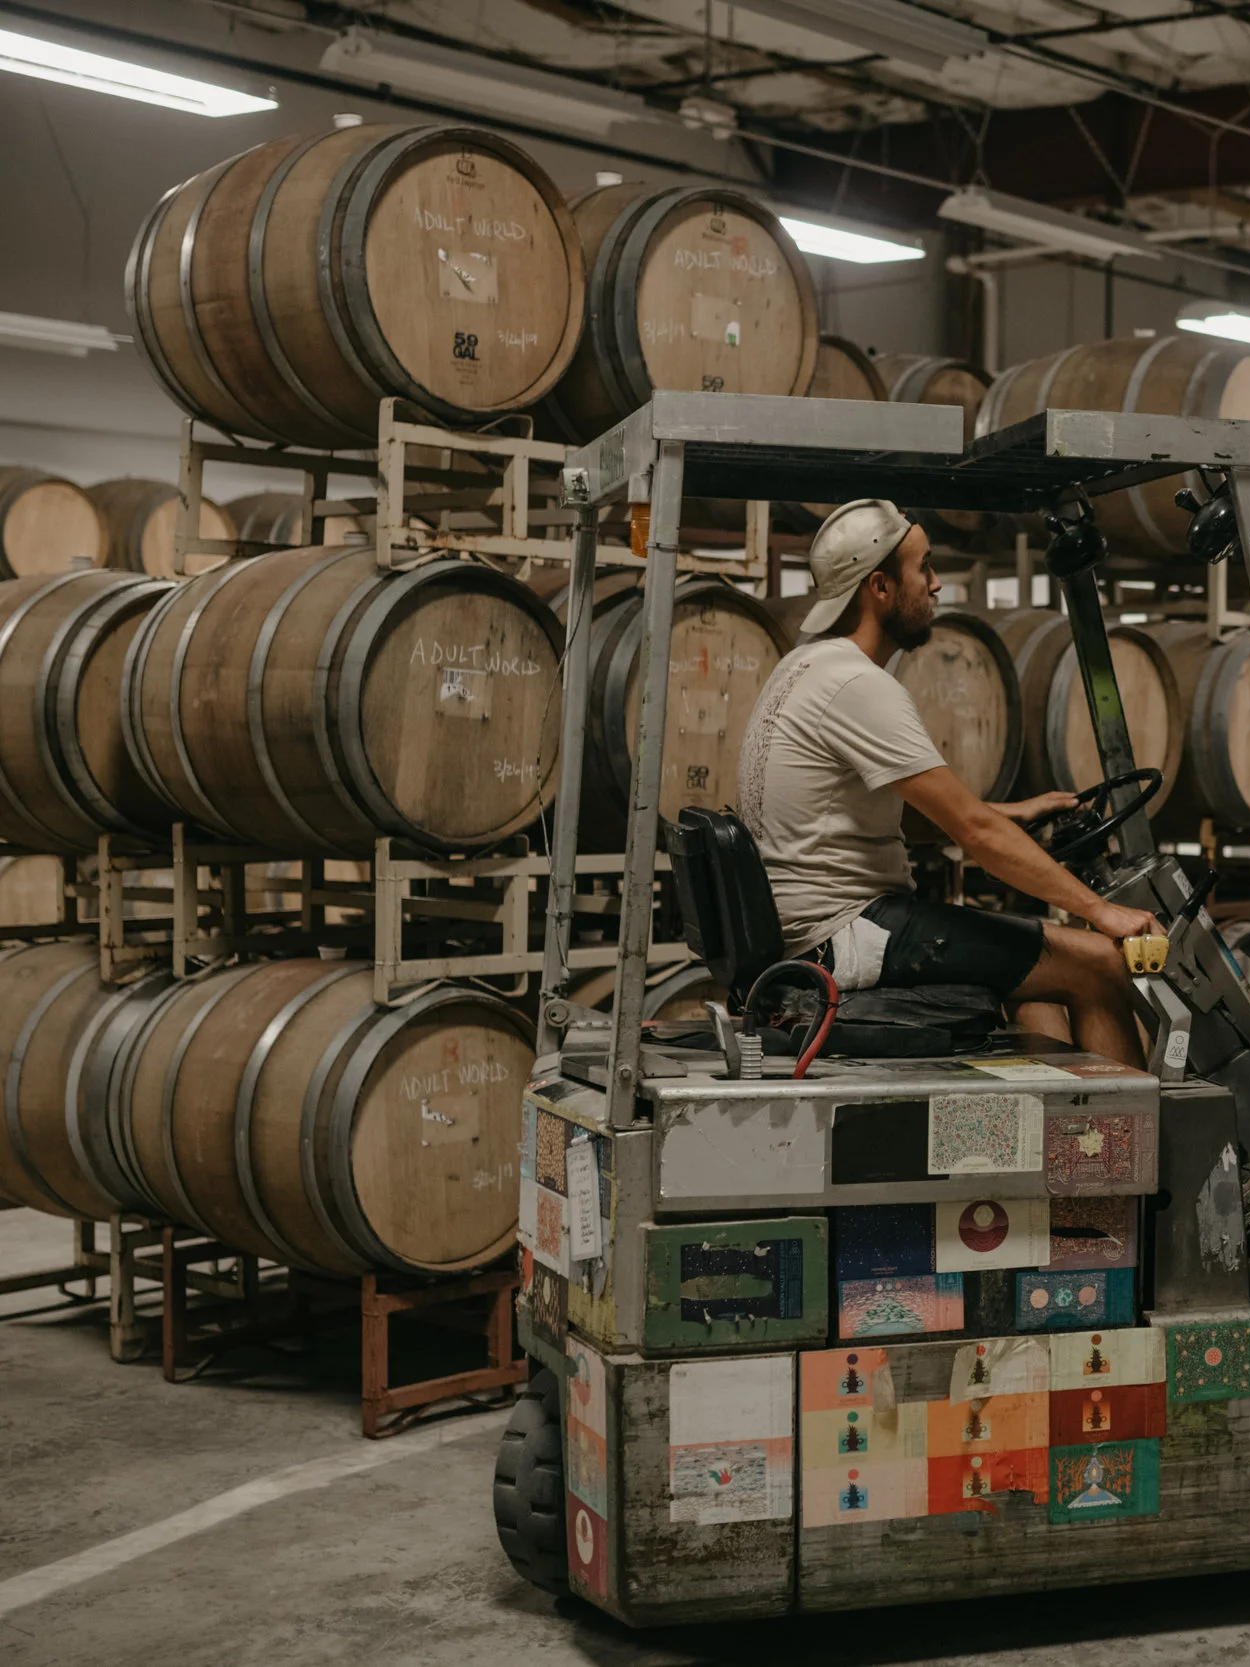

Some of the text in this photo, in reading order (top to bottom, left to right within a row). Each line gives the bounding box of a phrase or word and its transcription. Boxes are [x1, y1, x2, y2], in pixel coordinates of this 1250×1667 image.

[413, 206, 466, 235] ADULT
[674, 250, 721, 271] ADULT
[454, 332, 479, 348] 59
[452, 346, 481, 361] GAL
[410, 637, 541, 677] ADULT WORLD
[669, 656, 706, 674] DULT
[401, 1062, 508, 1100] ADULT WORLD
